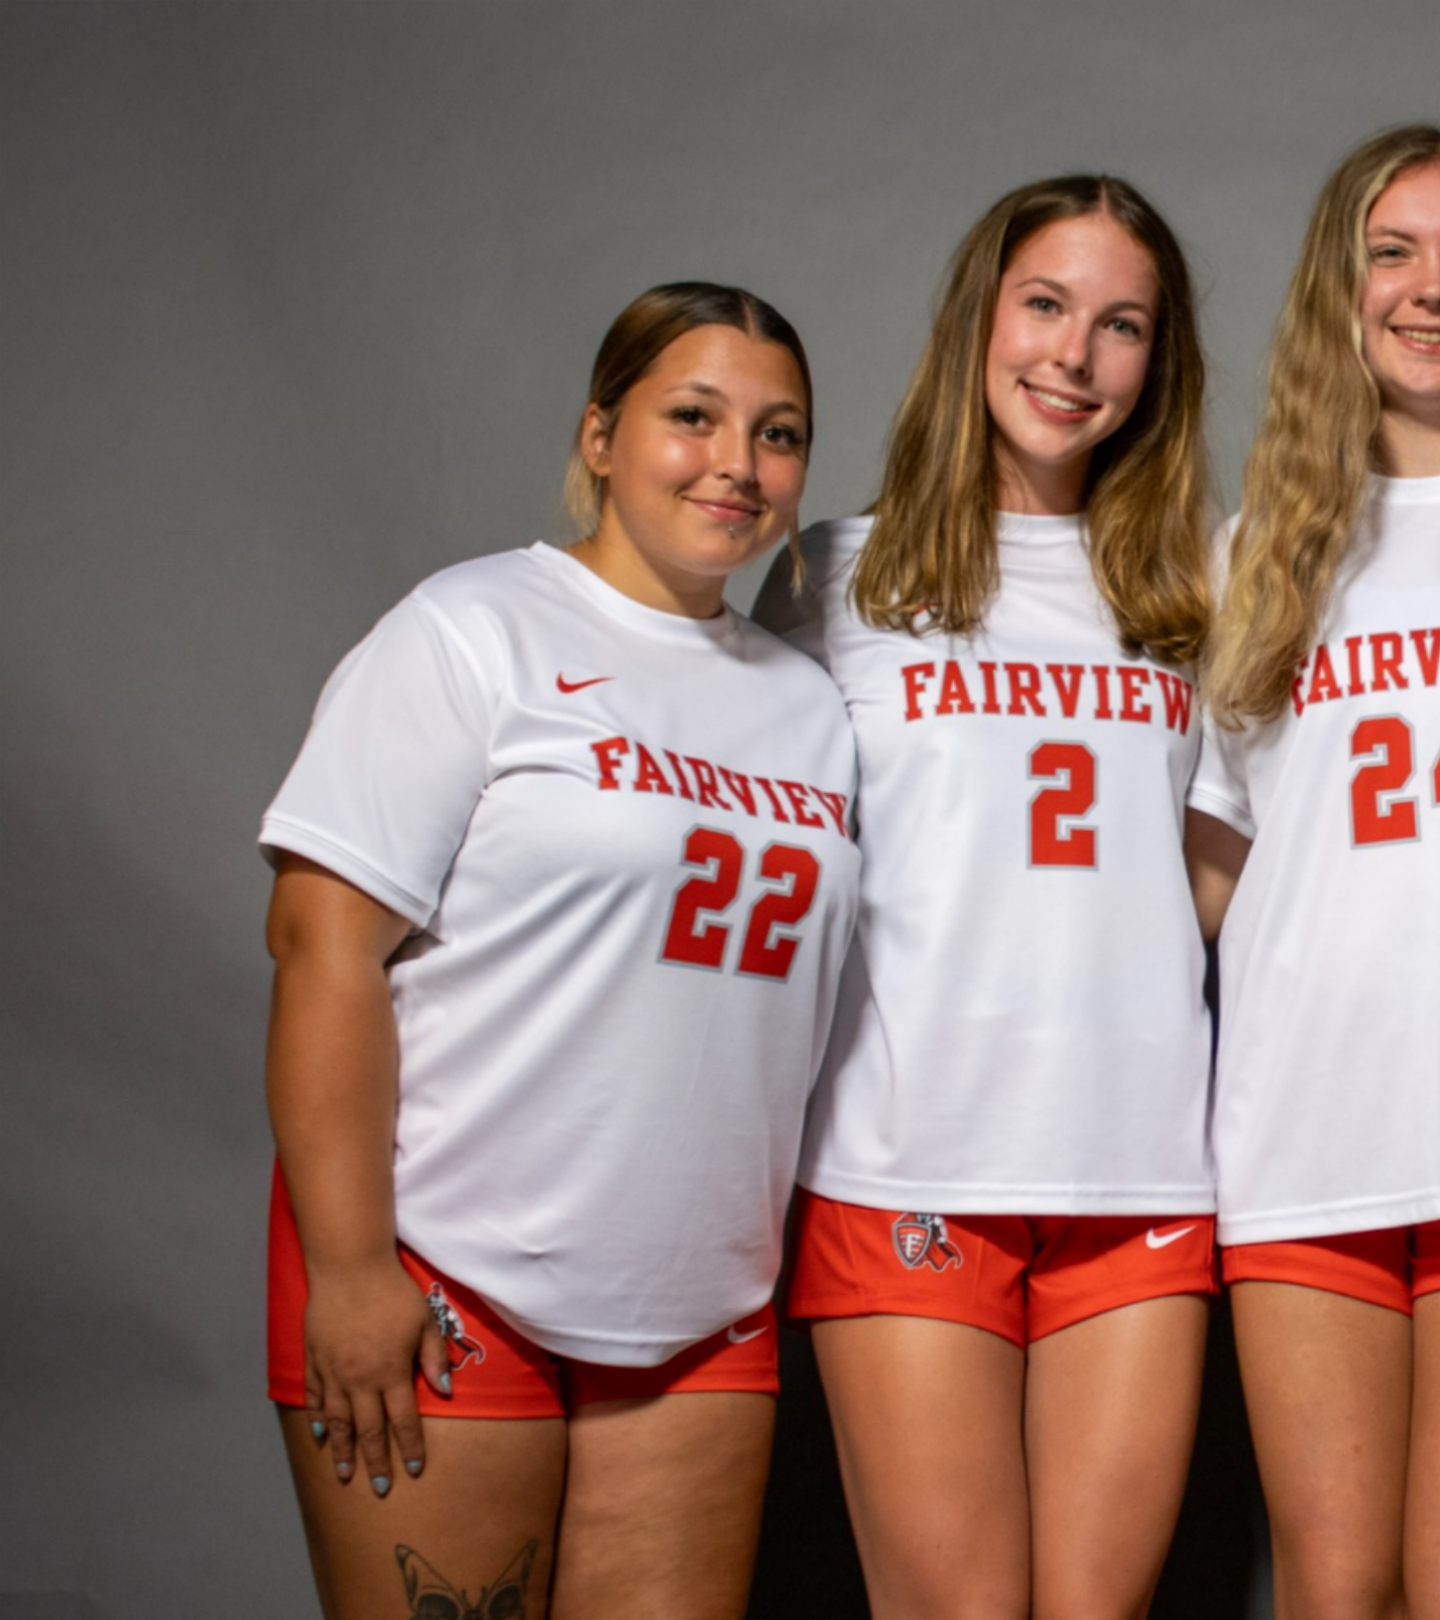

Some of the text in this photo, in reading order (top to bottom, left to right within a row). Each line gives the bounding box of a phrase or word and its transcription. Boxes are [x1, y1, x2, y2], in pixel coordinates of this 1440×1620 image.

[900, 660, 1193, 737] FAIRVIEW
[1026, 739, 1099, 872] 2
[656, 823, 822, 984] 22
